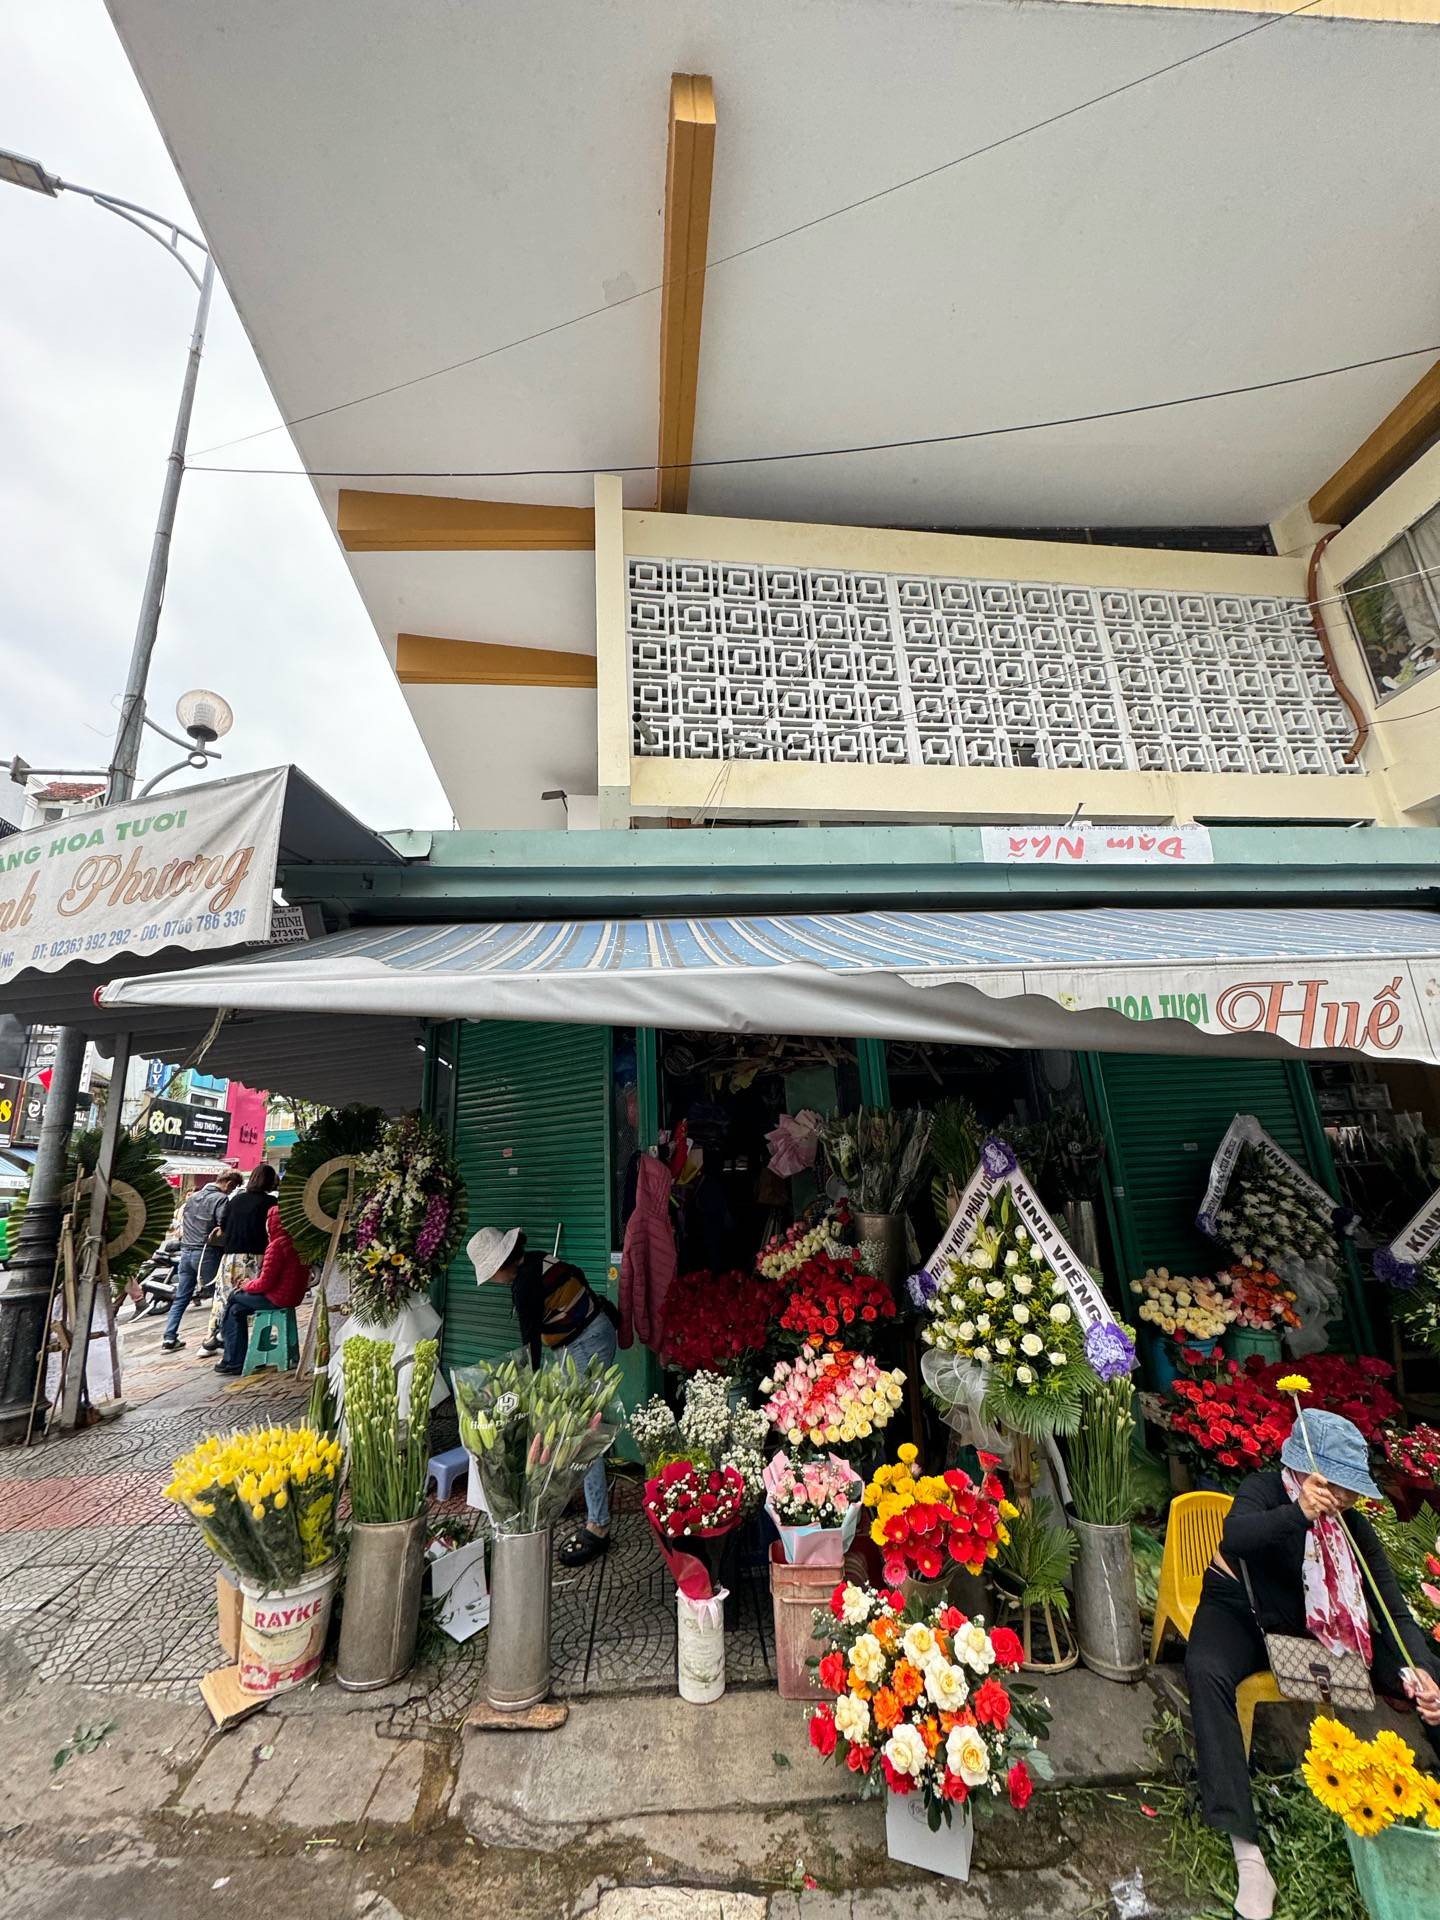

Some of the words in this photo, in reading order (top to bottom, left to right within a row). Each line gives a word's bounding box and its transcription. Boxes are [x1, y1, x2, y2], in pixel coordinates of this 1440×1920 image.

[0, 846, 41, 873] NG
[48, 828, 105, 858] HOA
[116, 810, 188, 841] TƯƠI
[57, 845, 255, 917] Phương
[1107, 995, 1154, 1020] HOA
[1158, 993, 1210, 1025] TƯƠI
[1216, 976, 1404, 1050] Huế
[951, 1218, 972, 1249] KÍNH
[965, 1188, 987, 1222] PHÂN
[1014, 1184, 1053, 1242] KÍNH
[1052, 1244, 1102, 1322] VIẾNG
[254, 1599, 322, 1629] RAYKE
